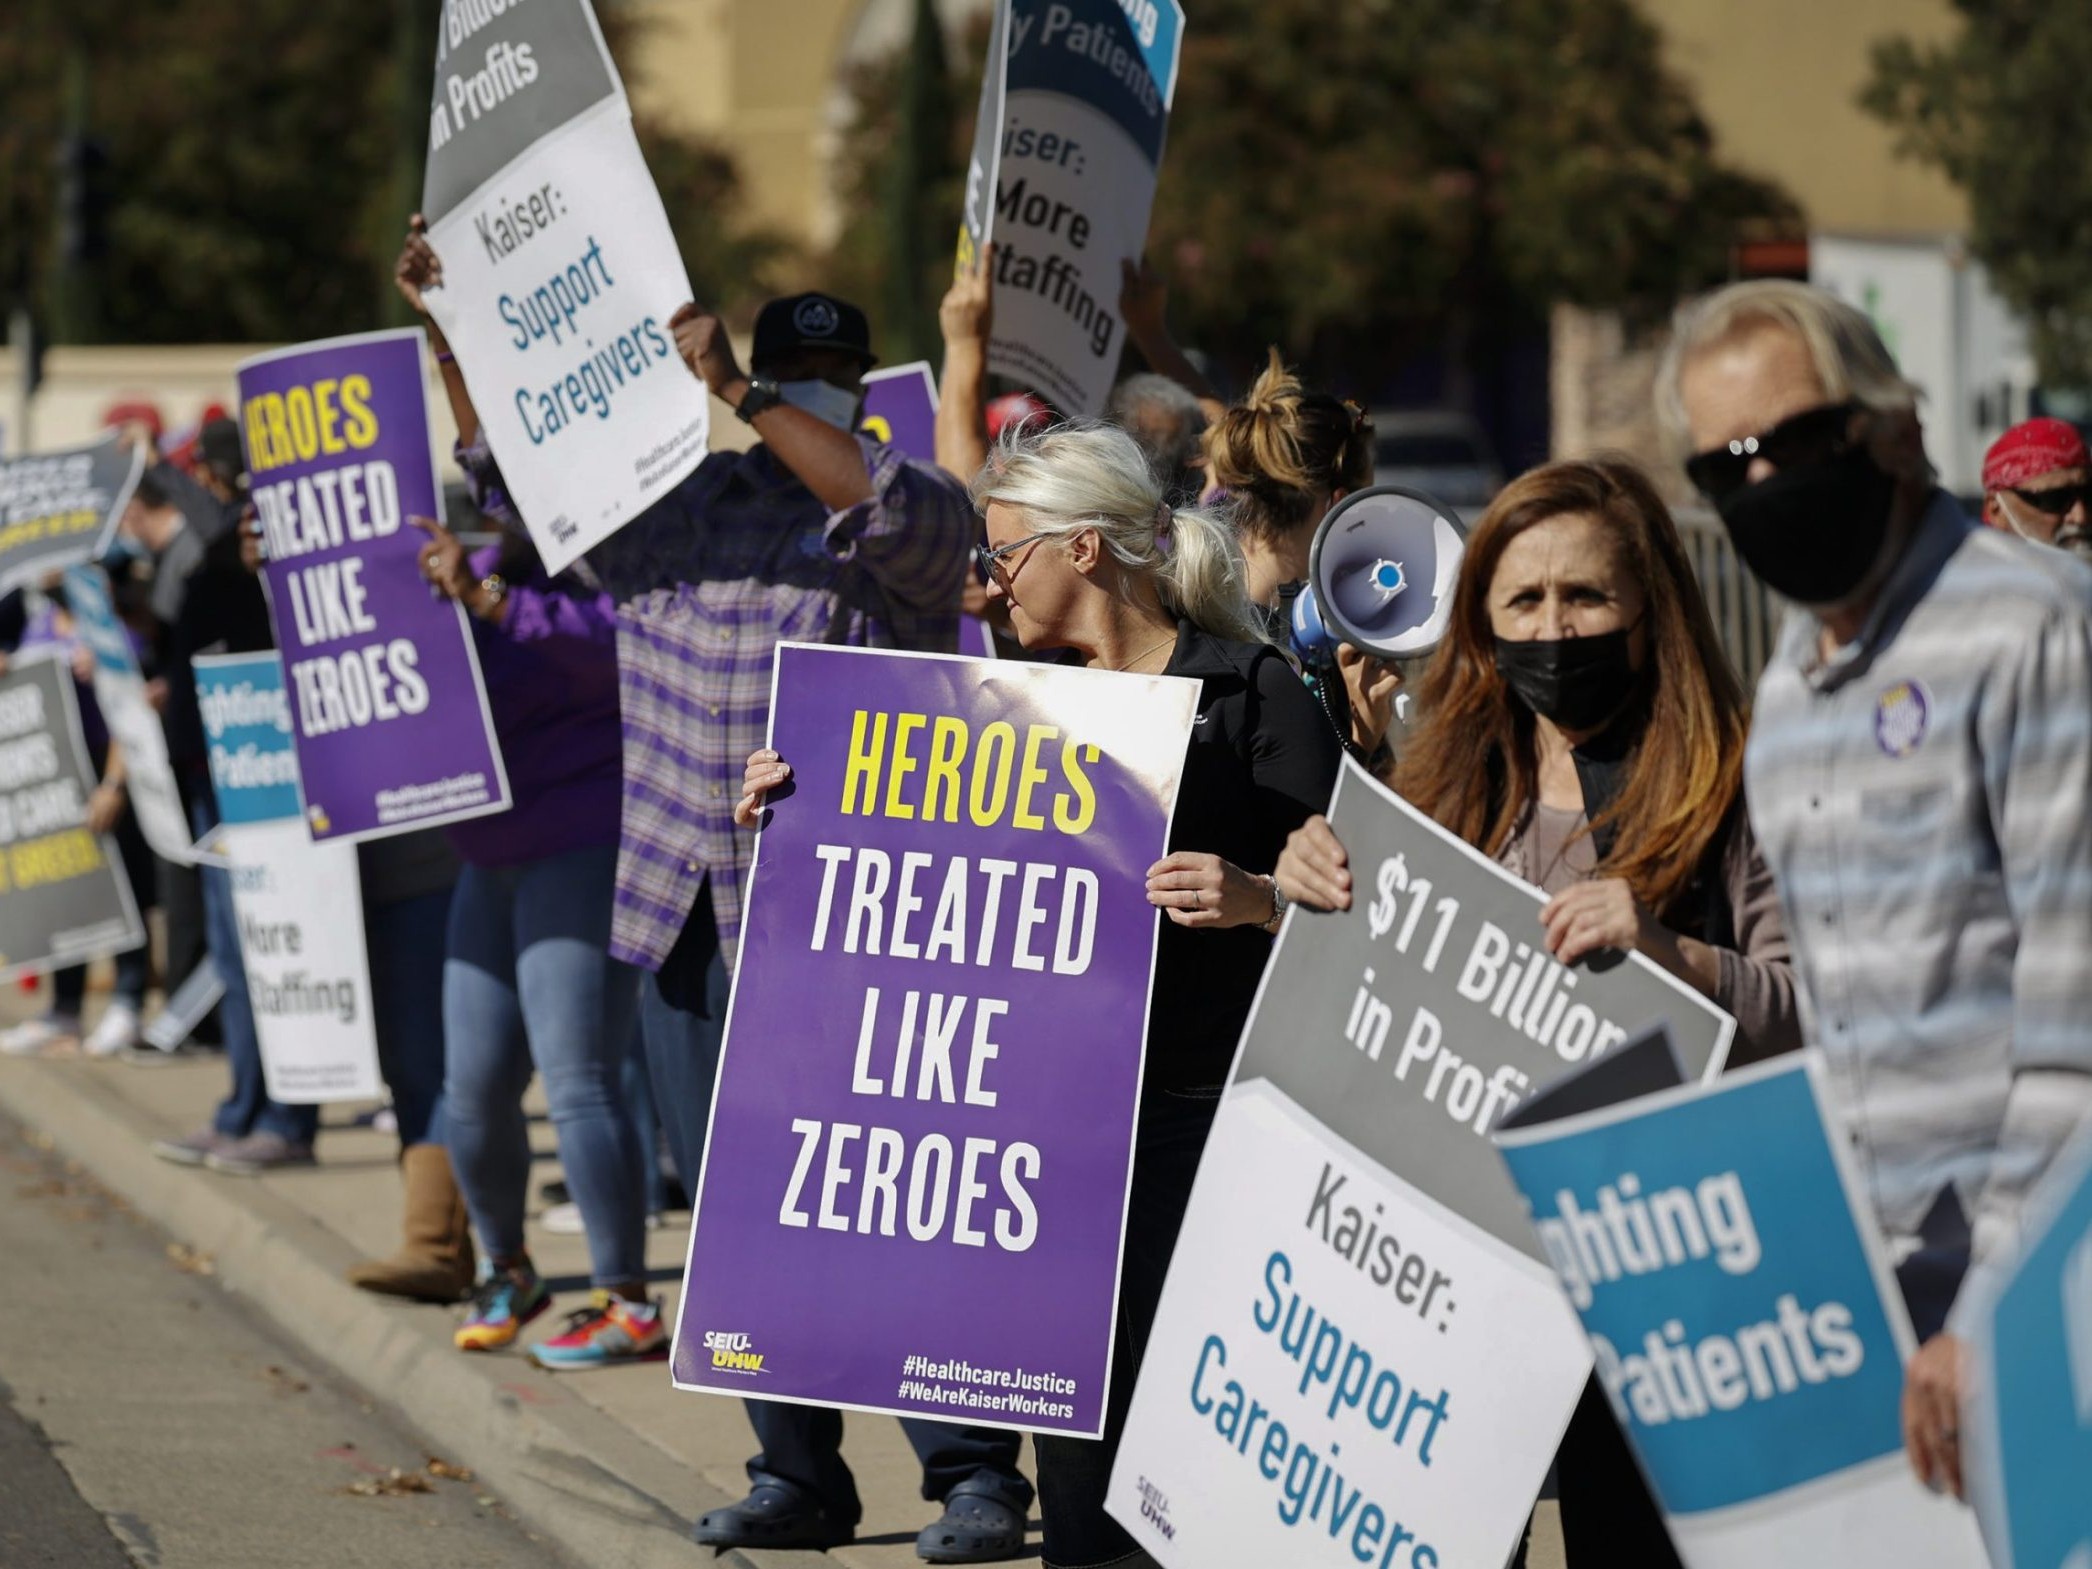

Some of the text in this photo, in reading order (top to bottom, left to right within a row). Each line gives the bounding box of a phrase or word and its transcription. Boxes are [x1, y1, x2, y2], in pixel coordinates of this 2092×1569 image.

[447, 41, 539, 131] Profits
[473, 182, 568, 266] Kaiser:
[497, 236, 613, 352] Support
[990, 238, 1115, 360] taffing
[514, 314, 668, 446] Caregivers
[288, 556, 377, 646] LIKE
[840, 710, 1101, 835] HEROES
[809, 844, 1100, 976] TREATED
[1368, 852, 1460, 974] $11
[850, 987, 1009, 1107] LIKE
[1345, 967, 1392, 1062] in
[779, 1118, 1041, 1252] ZEROES
[1305, 1162, 1455, 1334] Kaiser:
[703, 1331, 752, 1351] SEIU-
[712, 1350, 764, 1371] UHW
[903, 1355, 1076, 1395] #HealthcareJustice
[1253, 1251, 1449, 1467] Support
[898, 1380, 1074, 1419] #WeAreKaiserWorkers
[1141, 1500, 1175, 1540] UHW
